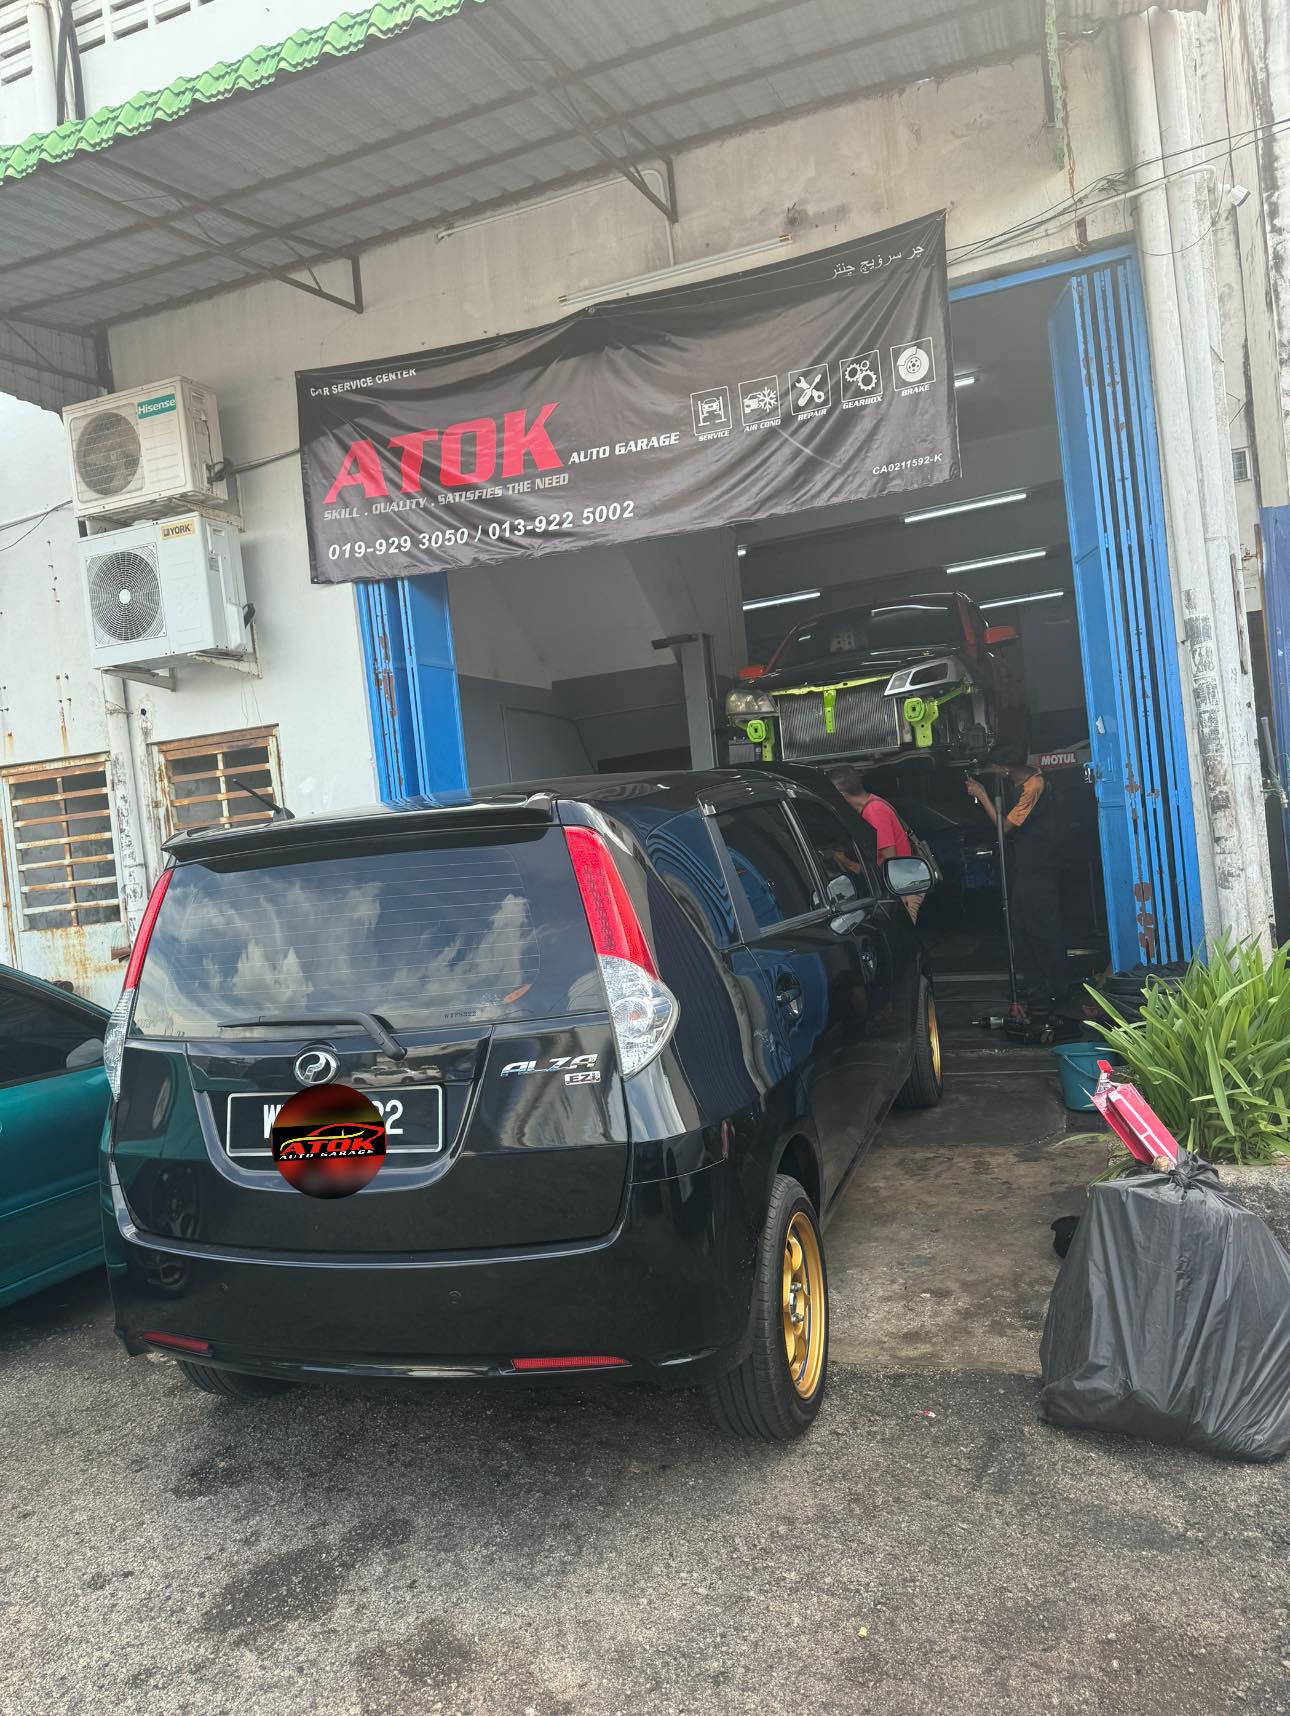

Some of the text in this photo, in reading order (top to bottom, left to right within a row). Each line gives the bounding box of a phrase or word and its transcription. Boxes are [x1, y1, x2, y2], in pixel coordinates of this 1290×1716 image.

[331, 376, 374, 395] SERVICE
[375, 368, 417, 385] CENTER
[901, 384, 930, 397] BRAKE
[137, 398, 176, 416] Hisense
[842, 395, 883, 410] GEARBOX
[797, 408, 827, 421] REPAIR
[743, 418, 781, 433] AIR COND
[698, 429, 730, 442] SERVICE
[320, 402, 680, 505] ATOK AUTO GARAGE
[872, 453, 943, 475] CA0211592-K
[323, 507, 361, 521] SKILL
[372, 496, 427, 514] QUALITY
[438, 485, 503, 505] SATISFIES
[507, 479, 531, 495] THE
[535, 473, 569, 491] NEED
[169, 523, 191, 536] YORK
[328, 535, 412, 561] 019-929
[418, 527, 469, 550] 3050
[488, 511, 573, 540] 013-922
[582, 500, 635, 525] 5002
[1041, 753, 1076, 766] MOTUL
[500, 1053, 599, 1077] ALZA
